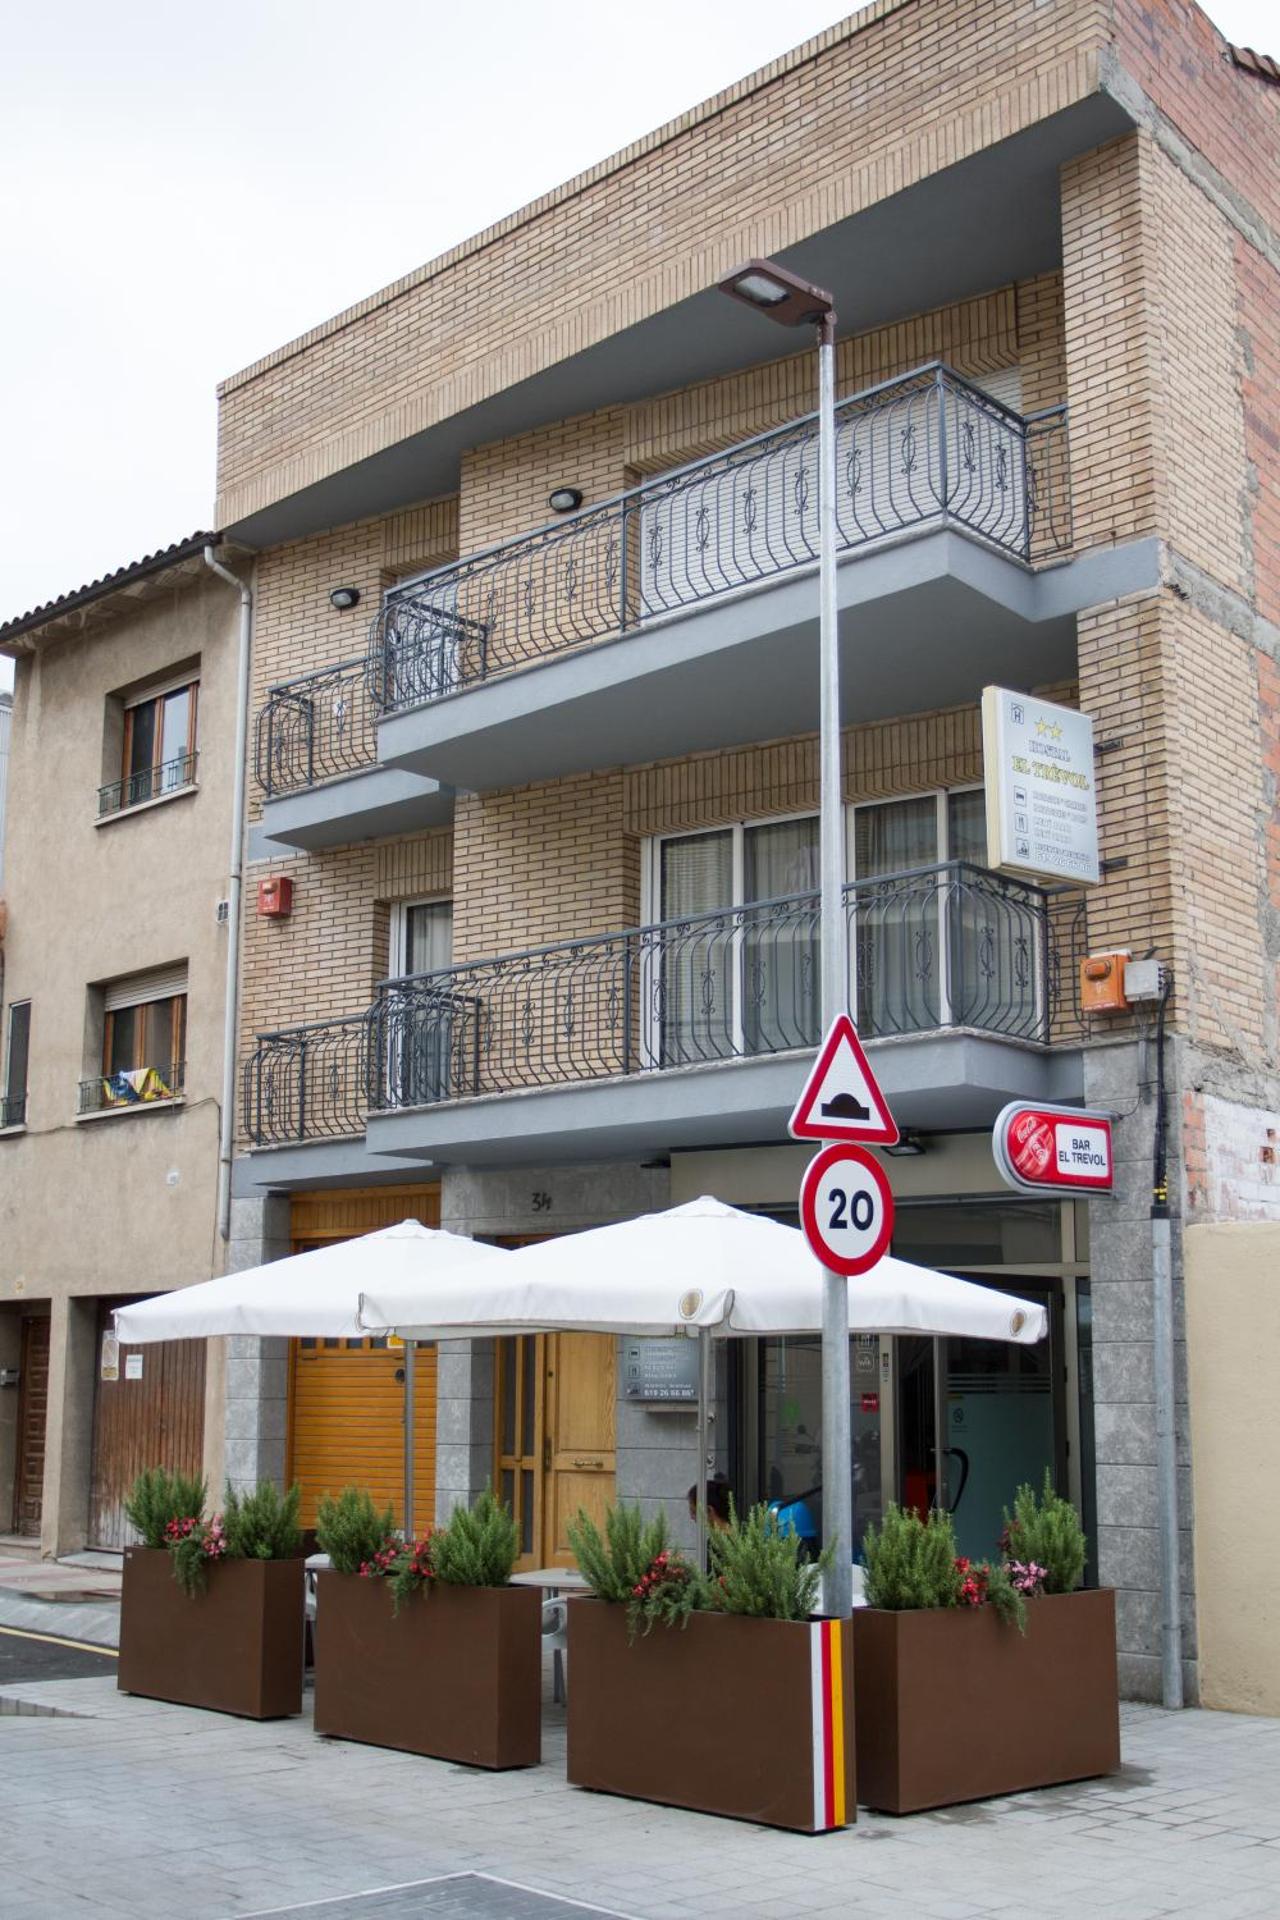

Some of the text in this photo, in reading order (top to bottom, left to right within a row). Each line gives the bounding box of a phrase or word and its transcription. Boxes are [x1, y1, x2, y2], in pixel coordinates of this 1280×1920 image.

[1012, 755, 1031, 775] EL
[1072, 1138, 1090, 1151] BAR
[1059, 1150, 1106, 1166] EL TREVOL
[531, 1191, 552, 1212] 34
[828, 1188, 874, 1231] 20
